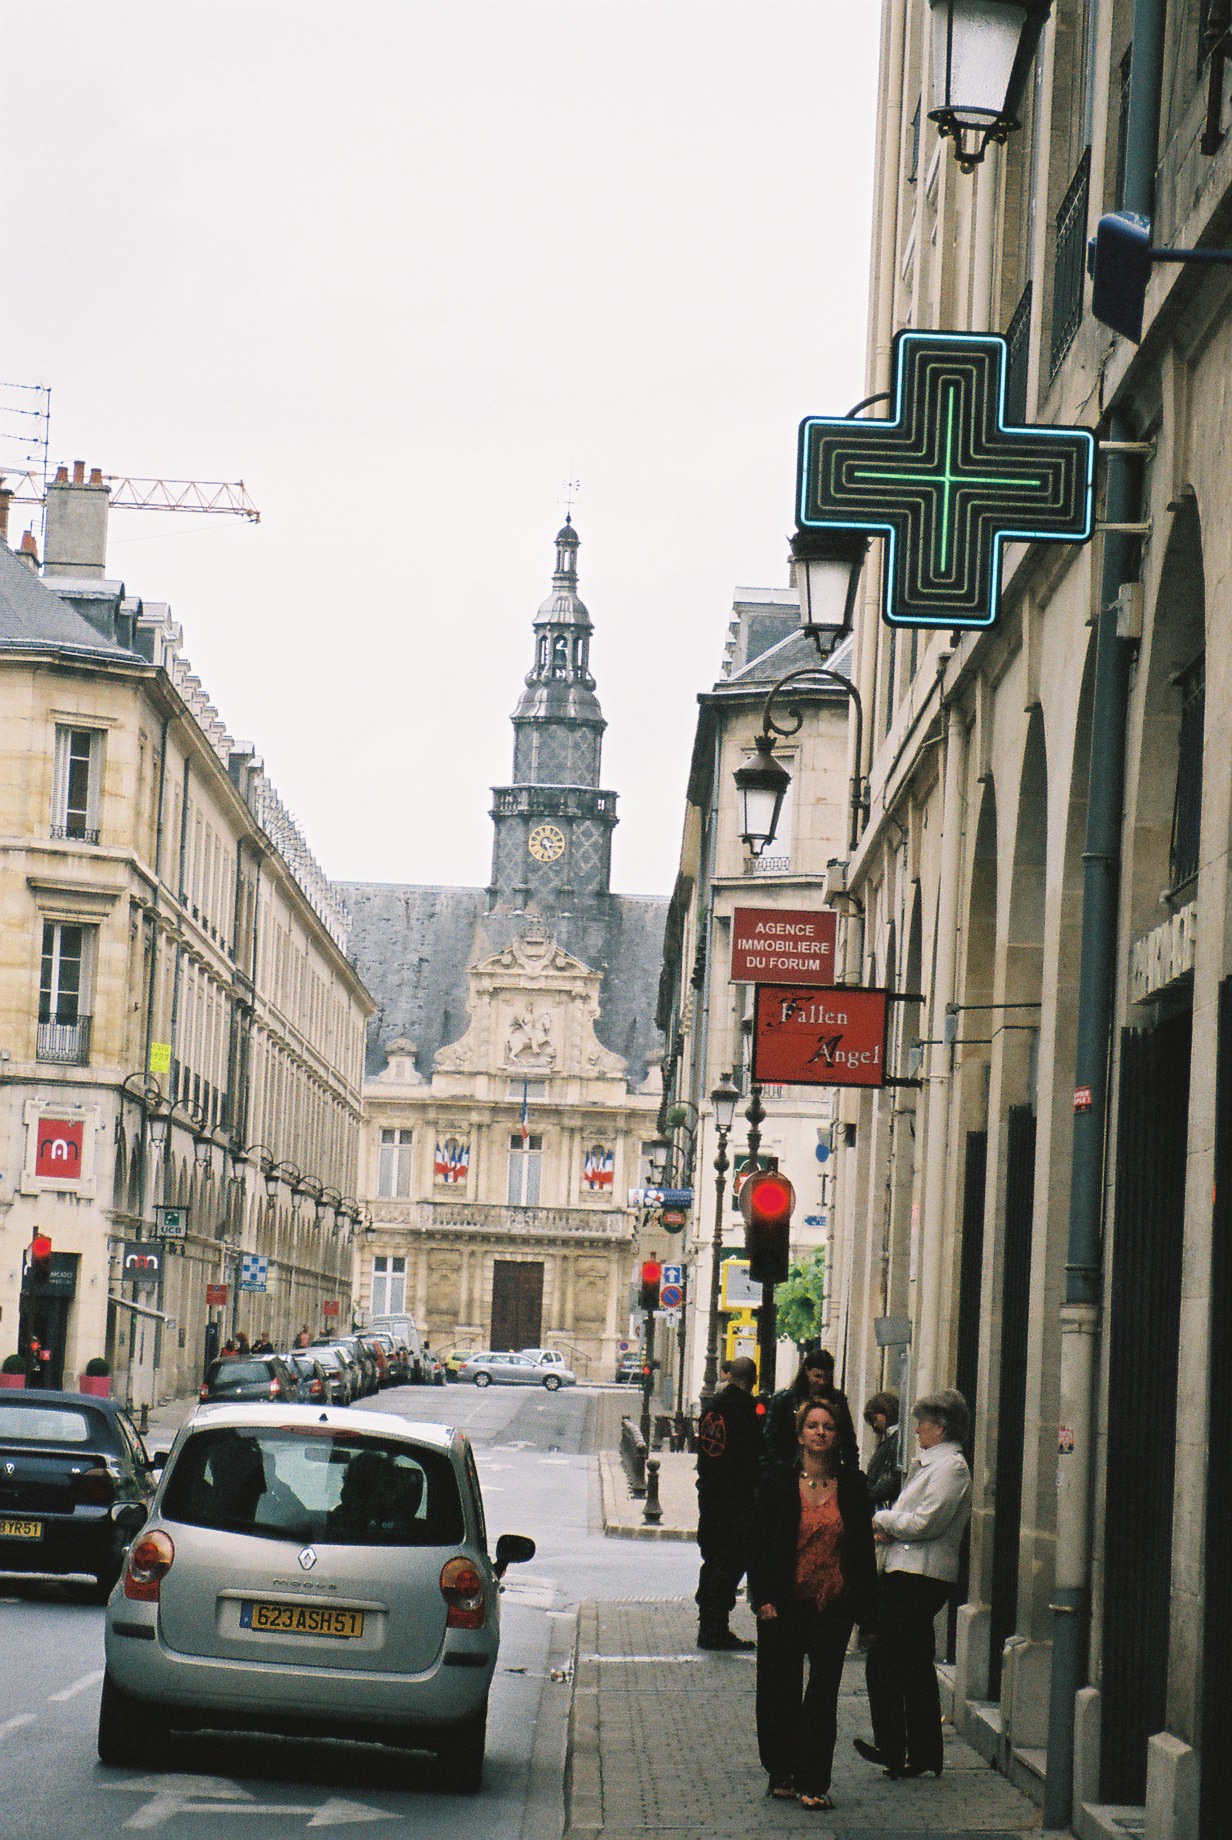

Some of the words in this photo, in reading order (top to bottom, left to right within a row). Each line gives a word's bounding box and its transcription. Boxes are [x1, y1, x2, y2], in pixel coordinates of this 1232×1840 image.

[755, 922, 815, 937] AGENCE
[746, 956, 766, 968] DU
[769, 957, 820, 971] FORUM
[778, 998, 849, 1026] Fallen
[811, 1036, 880, 1069] Angel
[161, 1226, 182, 1234] UCB
[257, 1606, 357, 1634] 623ASH51
